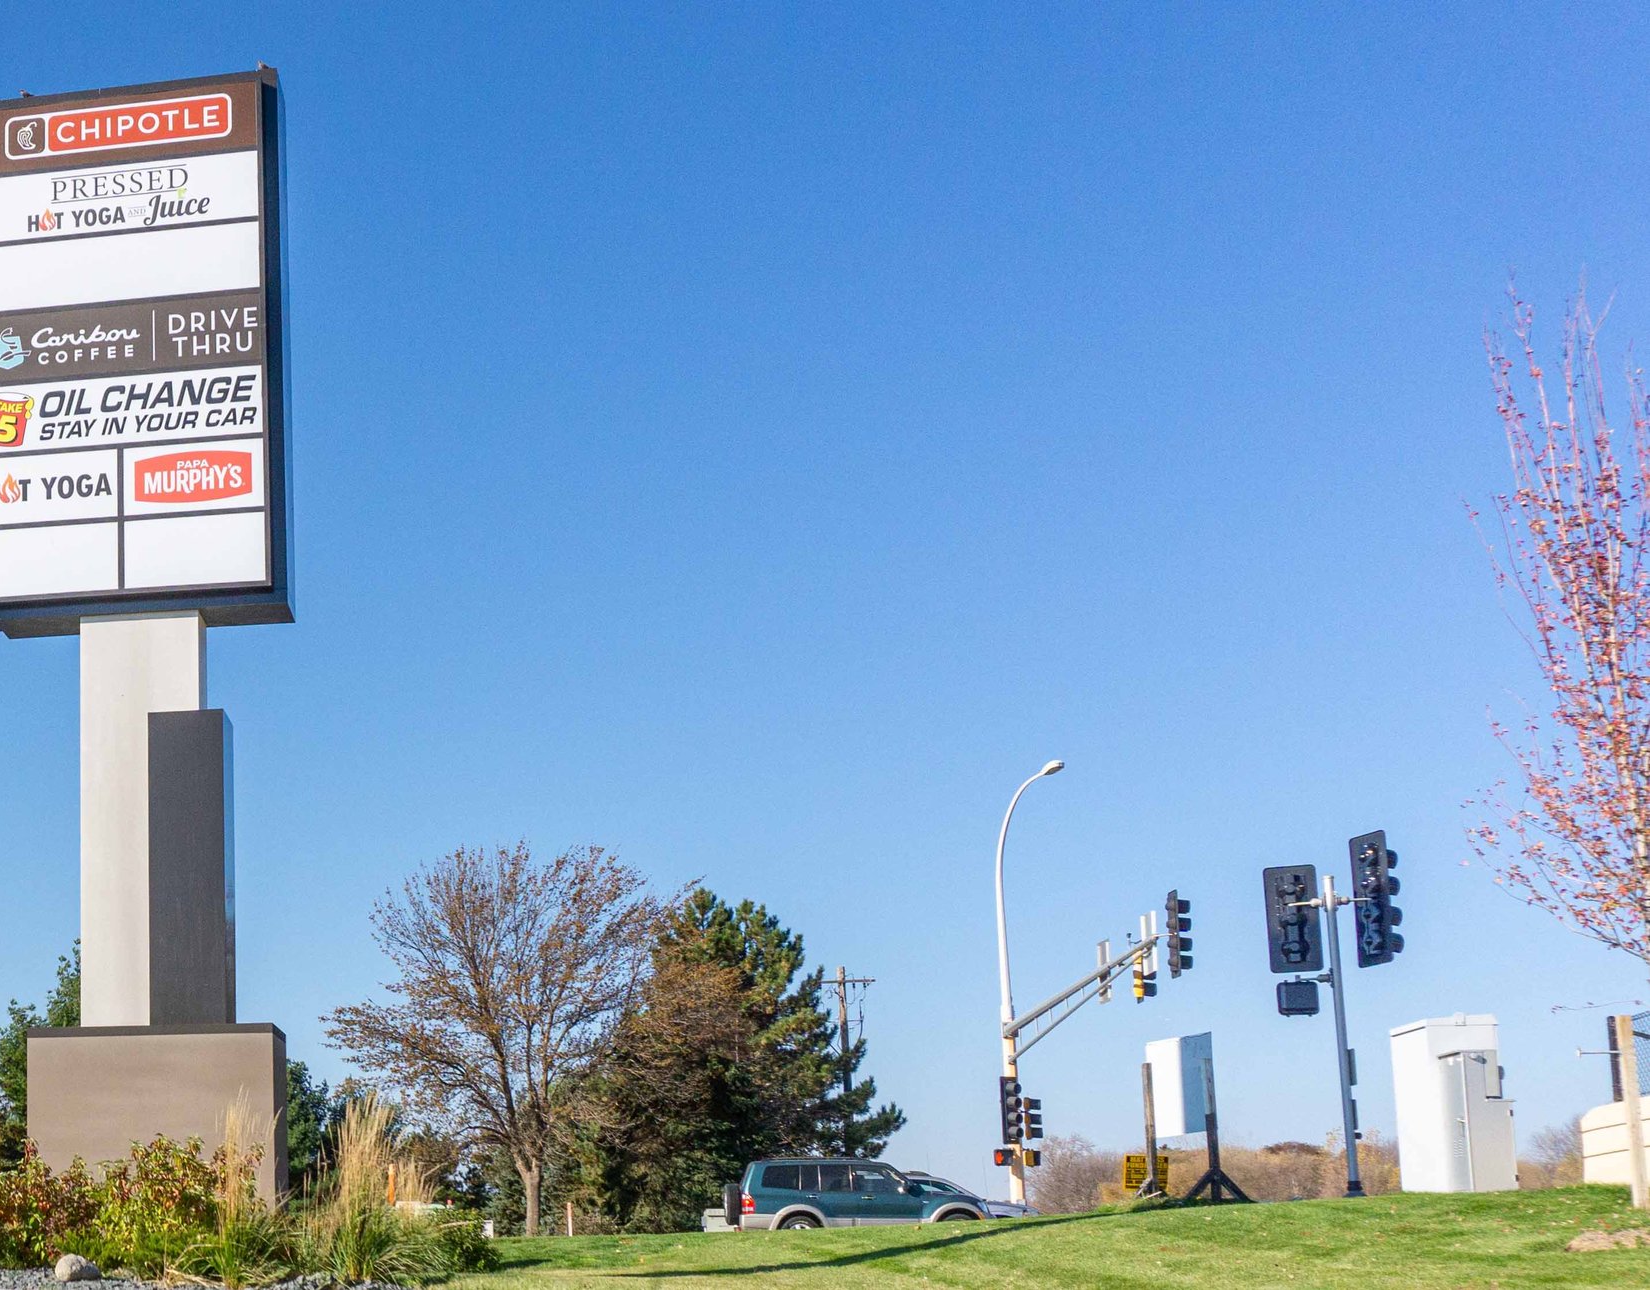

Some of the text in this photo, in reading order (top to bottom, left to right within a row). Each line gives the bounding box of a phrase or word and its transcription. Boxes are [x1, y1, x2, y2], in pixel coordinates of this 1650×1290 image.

[56, 105, 220, 143] CHIPOTLE
[51, 168, 188, 201] PRESSED
[71, 206, 126, 227] YOGA
[144, 193, 211, 226] Juice
[168, 306, 258, 335] DRIVE
[31, 324, 140, 348] Caribou
[172, 331, 253, 357] THRU
[38, 344, 134, 365] COFFEE
[39, 374, 257, 418] OIL CHANGE
[39, 406, 257, 441] STAY IN YOUR CAR
[144, 463, 242, 494] MURPHY'S
[176, 459, 209, 469] PAPA
[41, 473, 112, 500] YOGA
